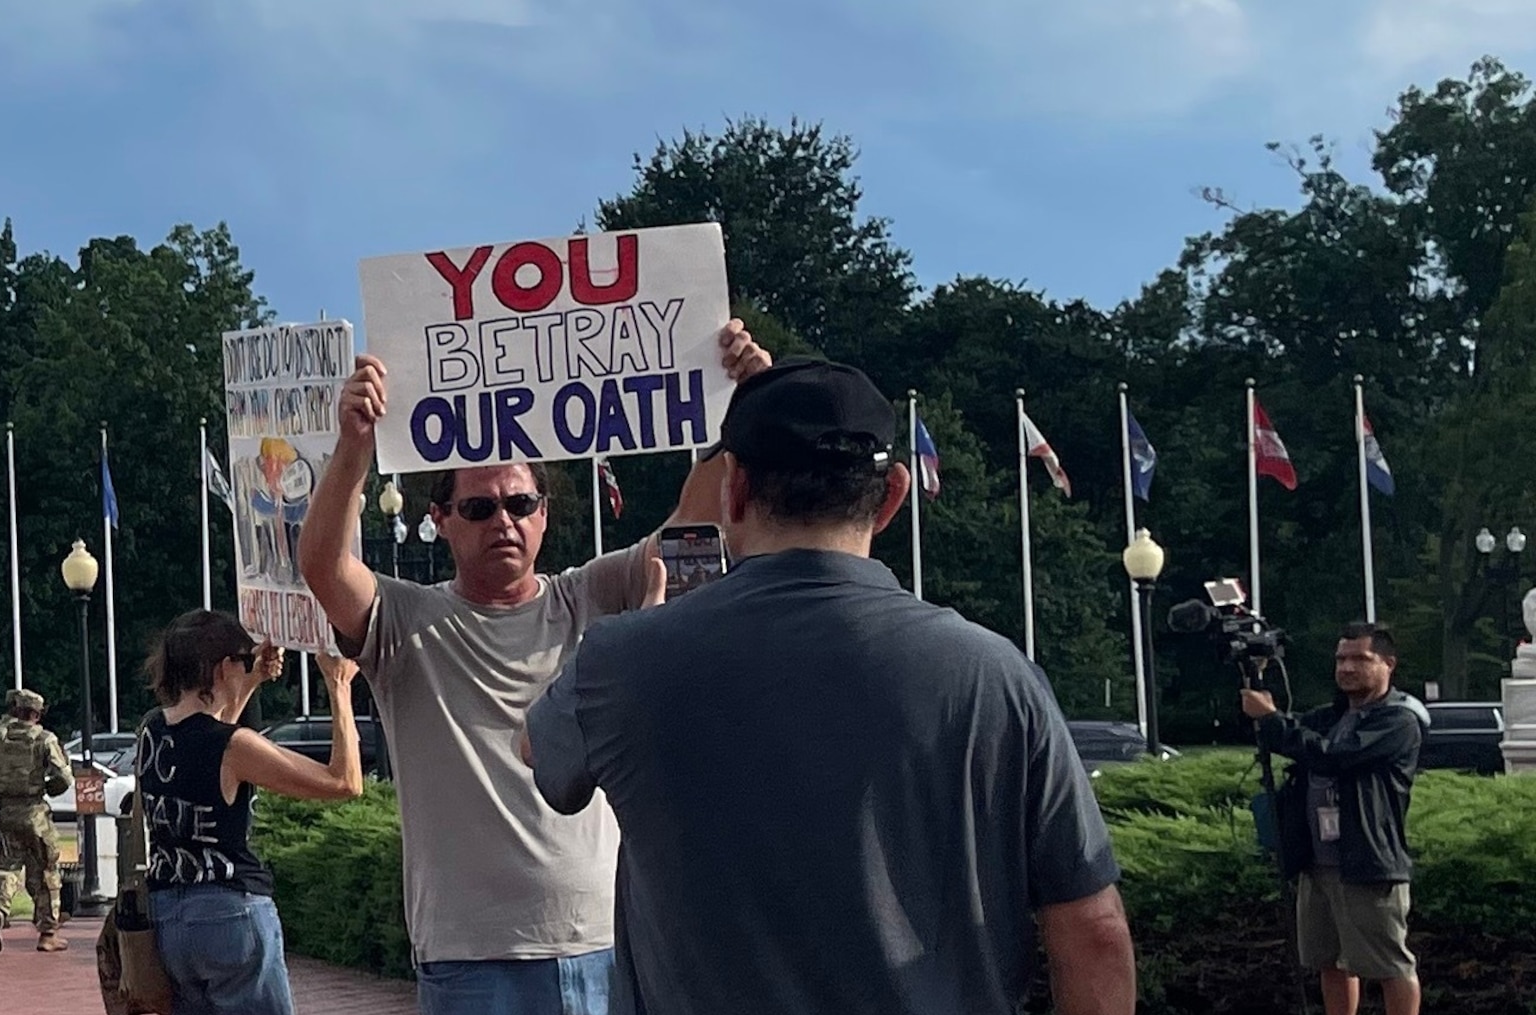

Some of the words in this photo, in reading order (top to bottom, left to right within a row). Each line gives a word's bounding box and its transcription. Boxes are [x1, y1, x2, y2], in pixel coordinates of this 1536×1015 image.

[424, 234, 639, 321] YOU
[425, 298, 685, 393] BETRAY
[410, 388, 543, 463] OUR
[552, 369, 708, 454] OATH
[138, 726, 176, 783] DC
